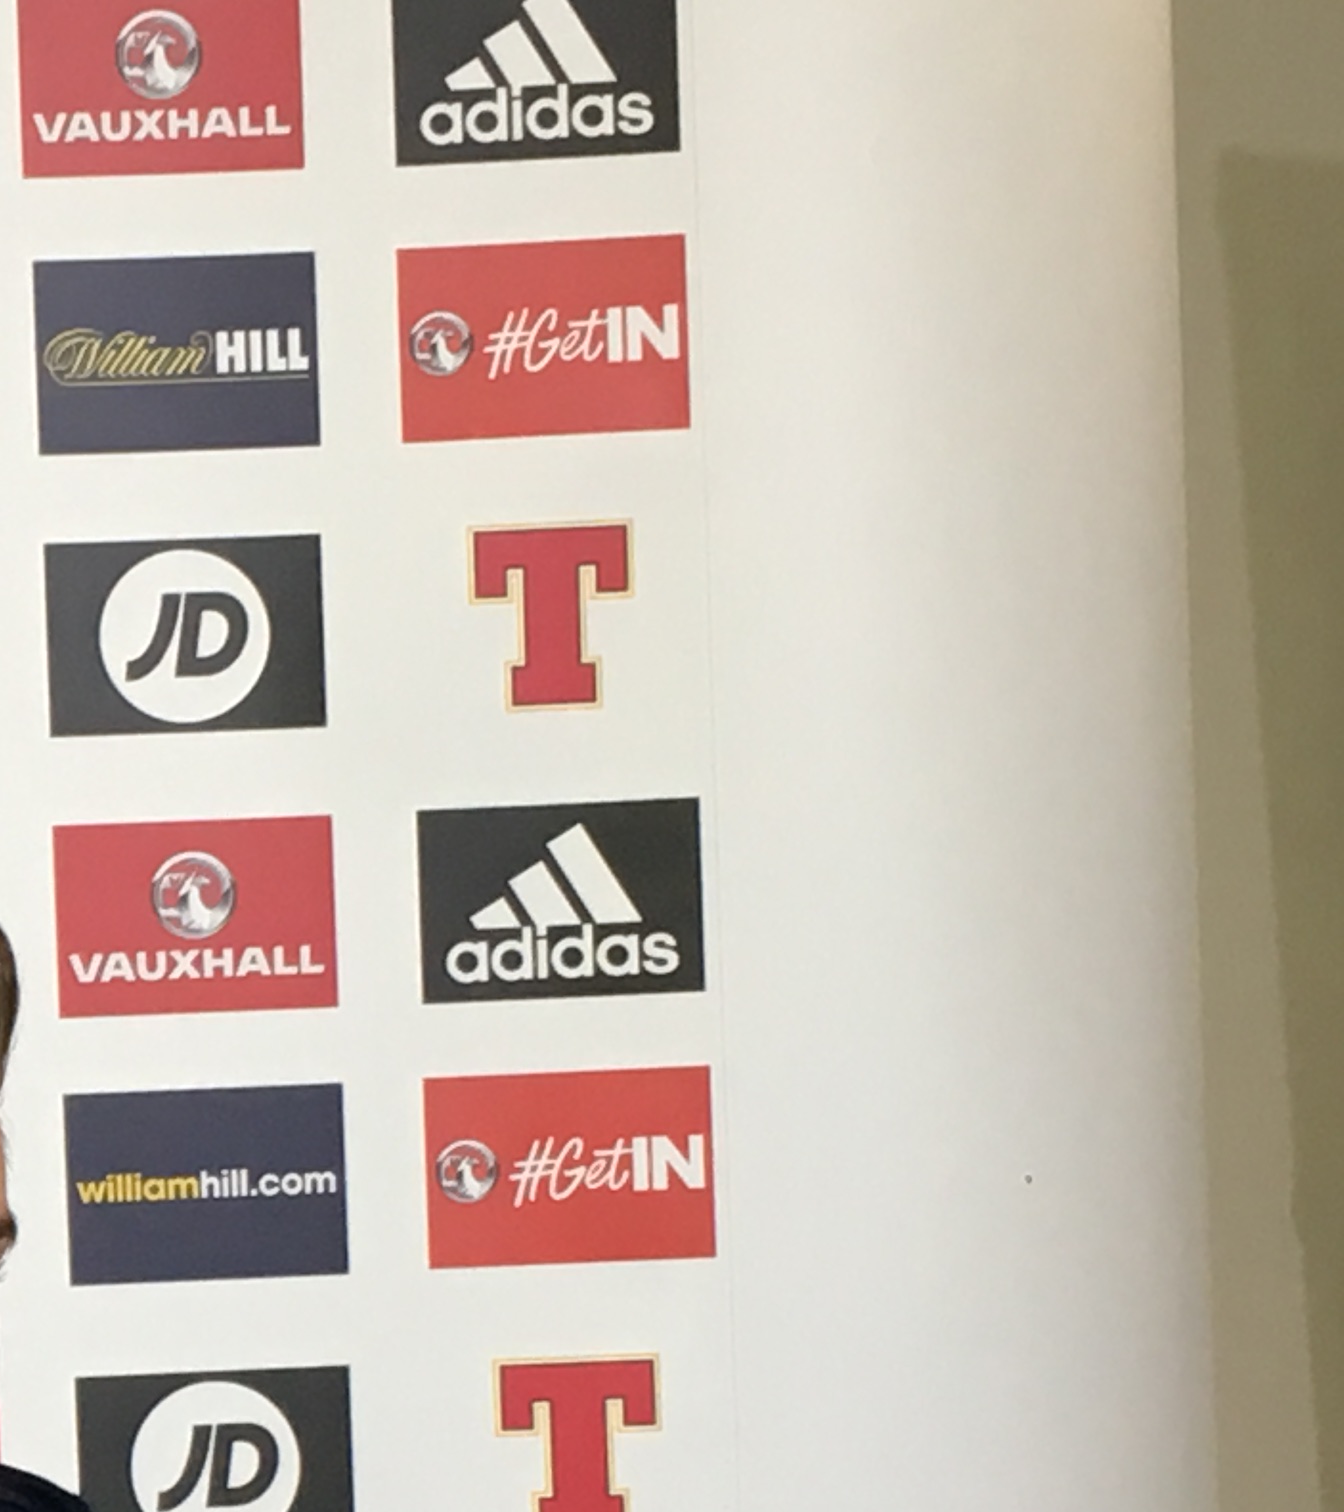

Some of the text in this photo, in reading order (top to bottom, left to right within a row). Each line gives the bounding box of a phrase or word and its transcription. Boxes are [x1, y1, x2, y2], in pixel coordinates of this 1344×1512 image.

[33, 105, 291, 144] VAUXHALL
[420, 86, 654, 147] adidas
[43, 327, 309, 385] William HILL
[483, 303, 679, 381] #GetIN
[125, 591, 248, 683] JD
[468, 519, 633, 713] T
[68, 945, 325, 984] VAUXHALL
[446, 924, 679, 984] adidas
[76, 1168, 337, 1205] williamhill.com
[510, 1134, 705, 1209] #GetIN
[157, 1422, 280, 1512] JD
